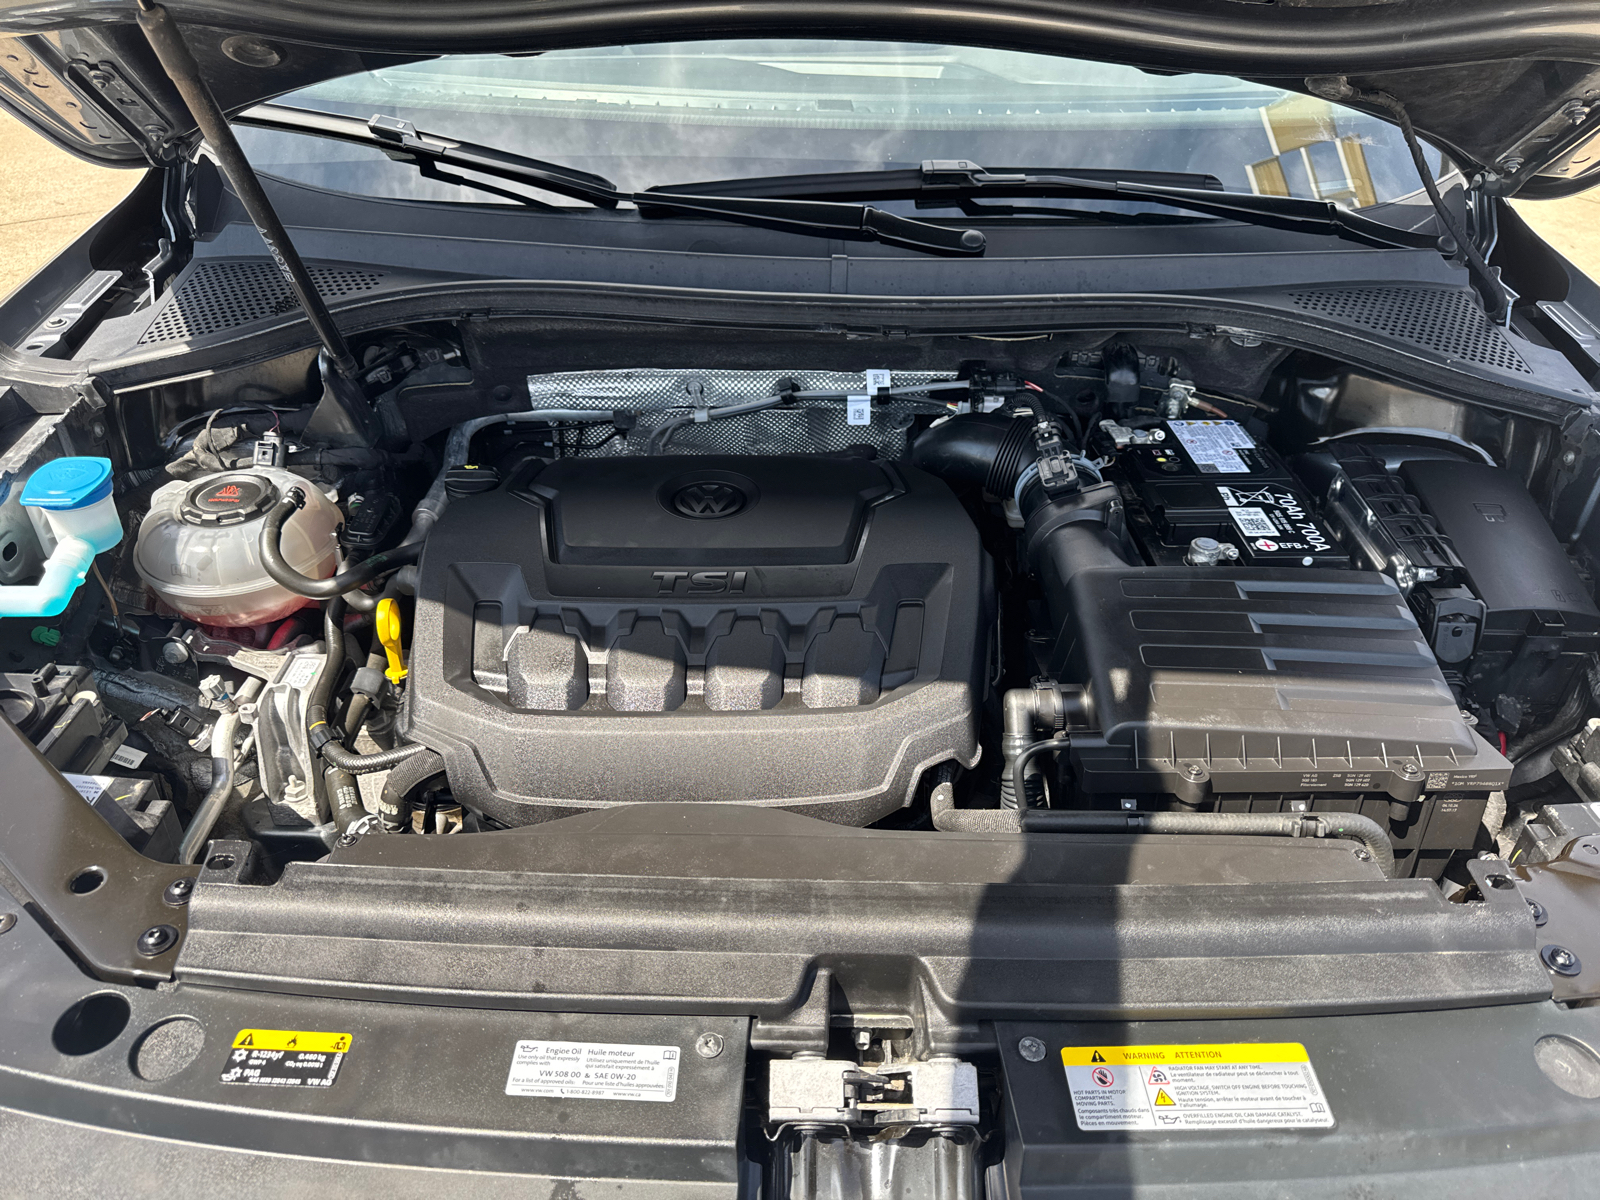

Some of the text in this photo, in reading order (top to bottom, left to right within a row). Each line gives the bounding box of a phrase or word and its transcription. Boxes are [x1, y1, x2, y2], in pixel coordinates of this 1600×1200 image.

[1274, 493, 1306, 520] 70Ah
[1296, 522, 1331, 552] 700A
[652, 571, 748, 594] TSI
[251, 1050, 284, 1061] R-1234yf
[546, 1047, 569, 1055] Engine
[1123, 1050, 1222, 1060] WARNING ATTENTION
[243, 1069, 261, 1077] PAG
